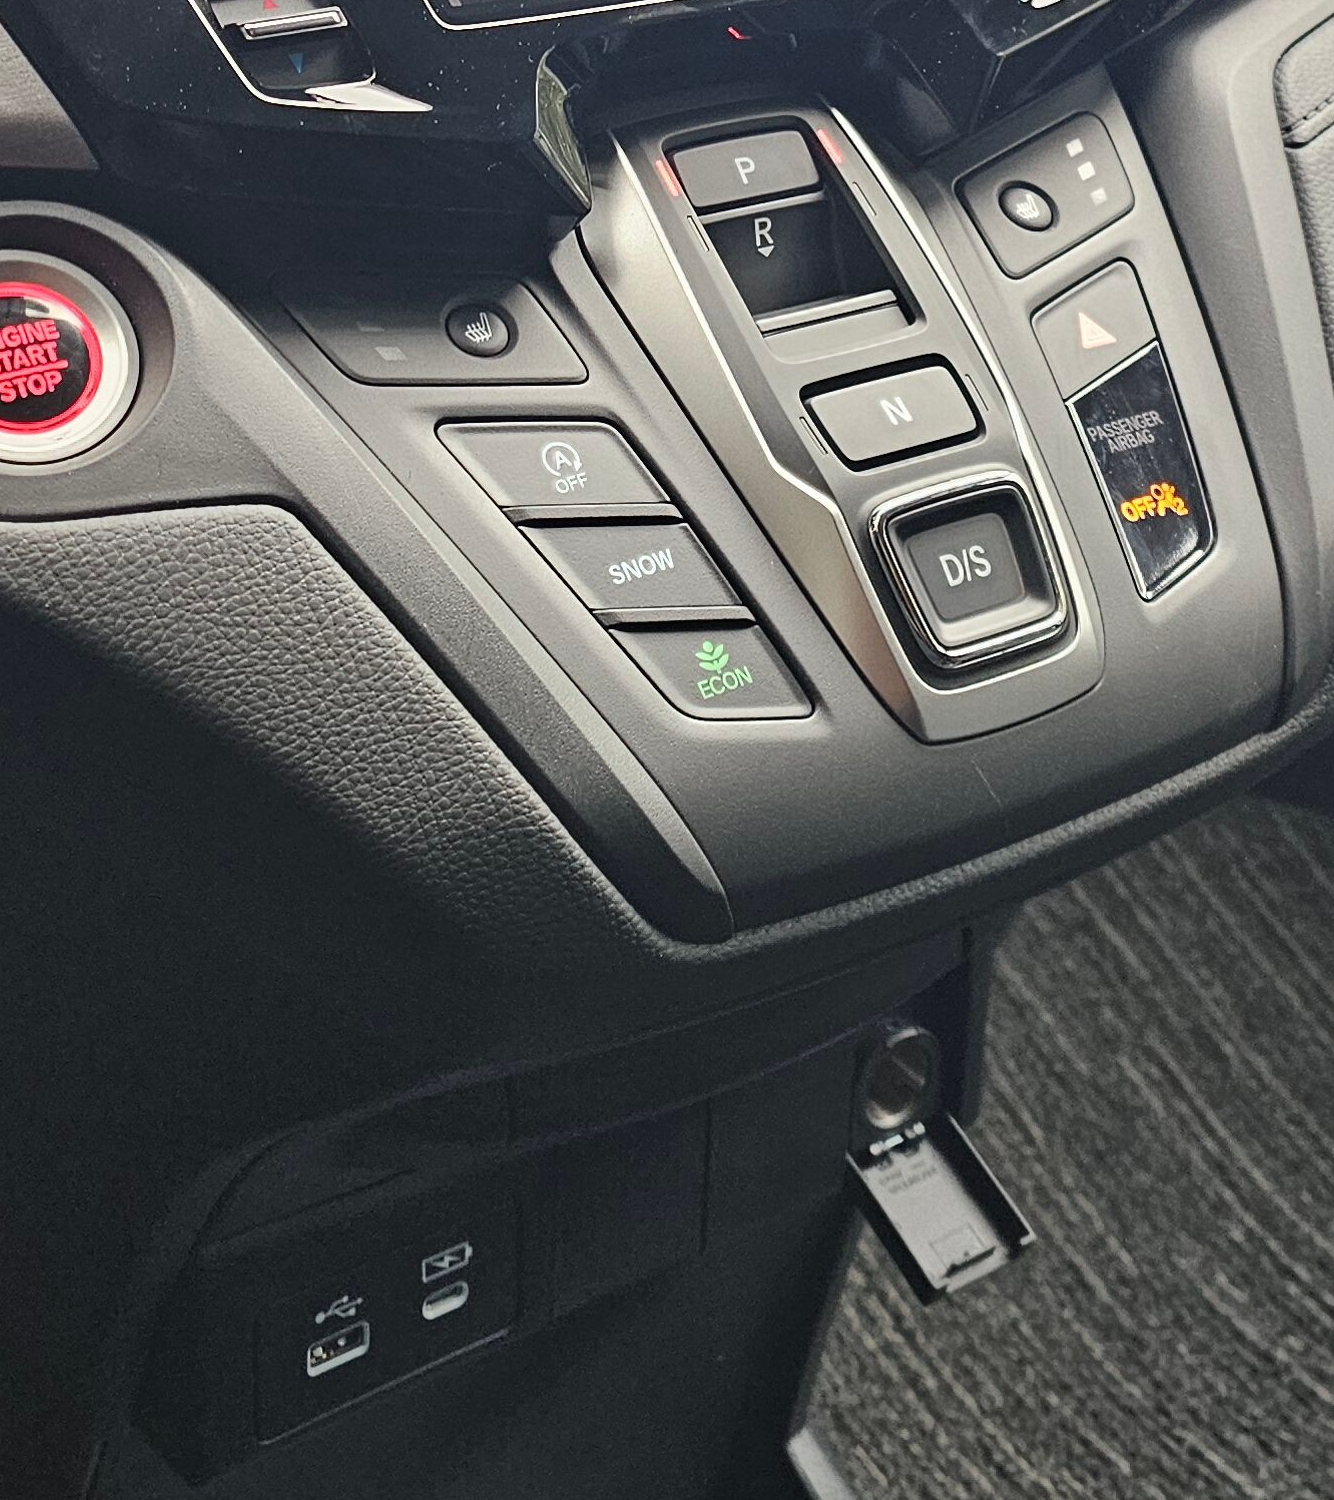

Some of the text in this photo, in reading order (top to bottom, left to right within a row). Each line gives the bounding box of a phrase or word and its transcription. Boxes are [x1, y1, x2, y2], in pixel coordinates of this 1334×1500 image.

[734, 155, 756, 185] P
[753, 218, 774, 247] R
[880, 396, 912, 425] N
[1087, 410, 1164, 442] PASSENGER
[1107, 429, 1155, 453] AIRBAG
[555, 451, 572, 470] A
[556, 472, 587, 494] OFF
[1120, 496, 1157, 522] OFF
[608, 549, 674, 584] SNOW
[939, 545, 992, 587] D/S
[697, 665, 753, 699] ECON
